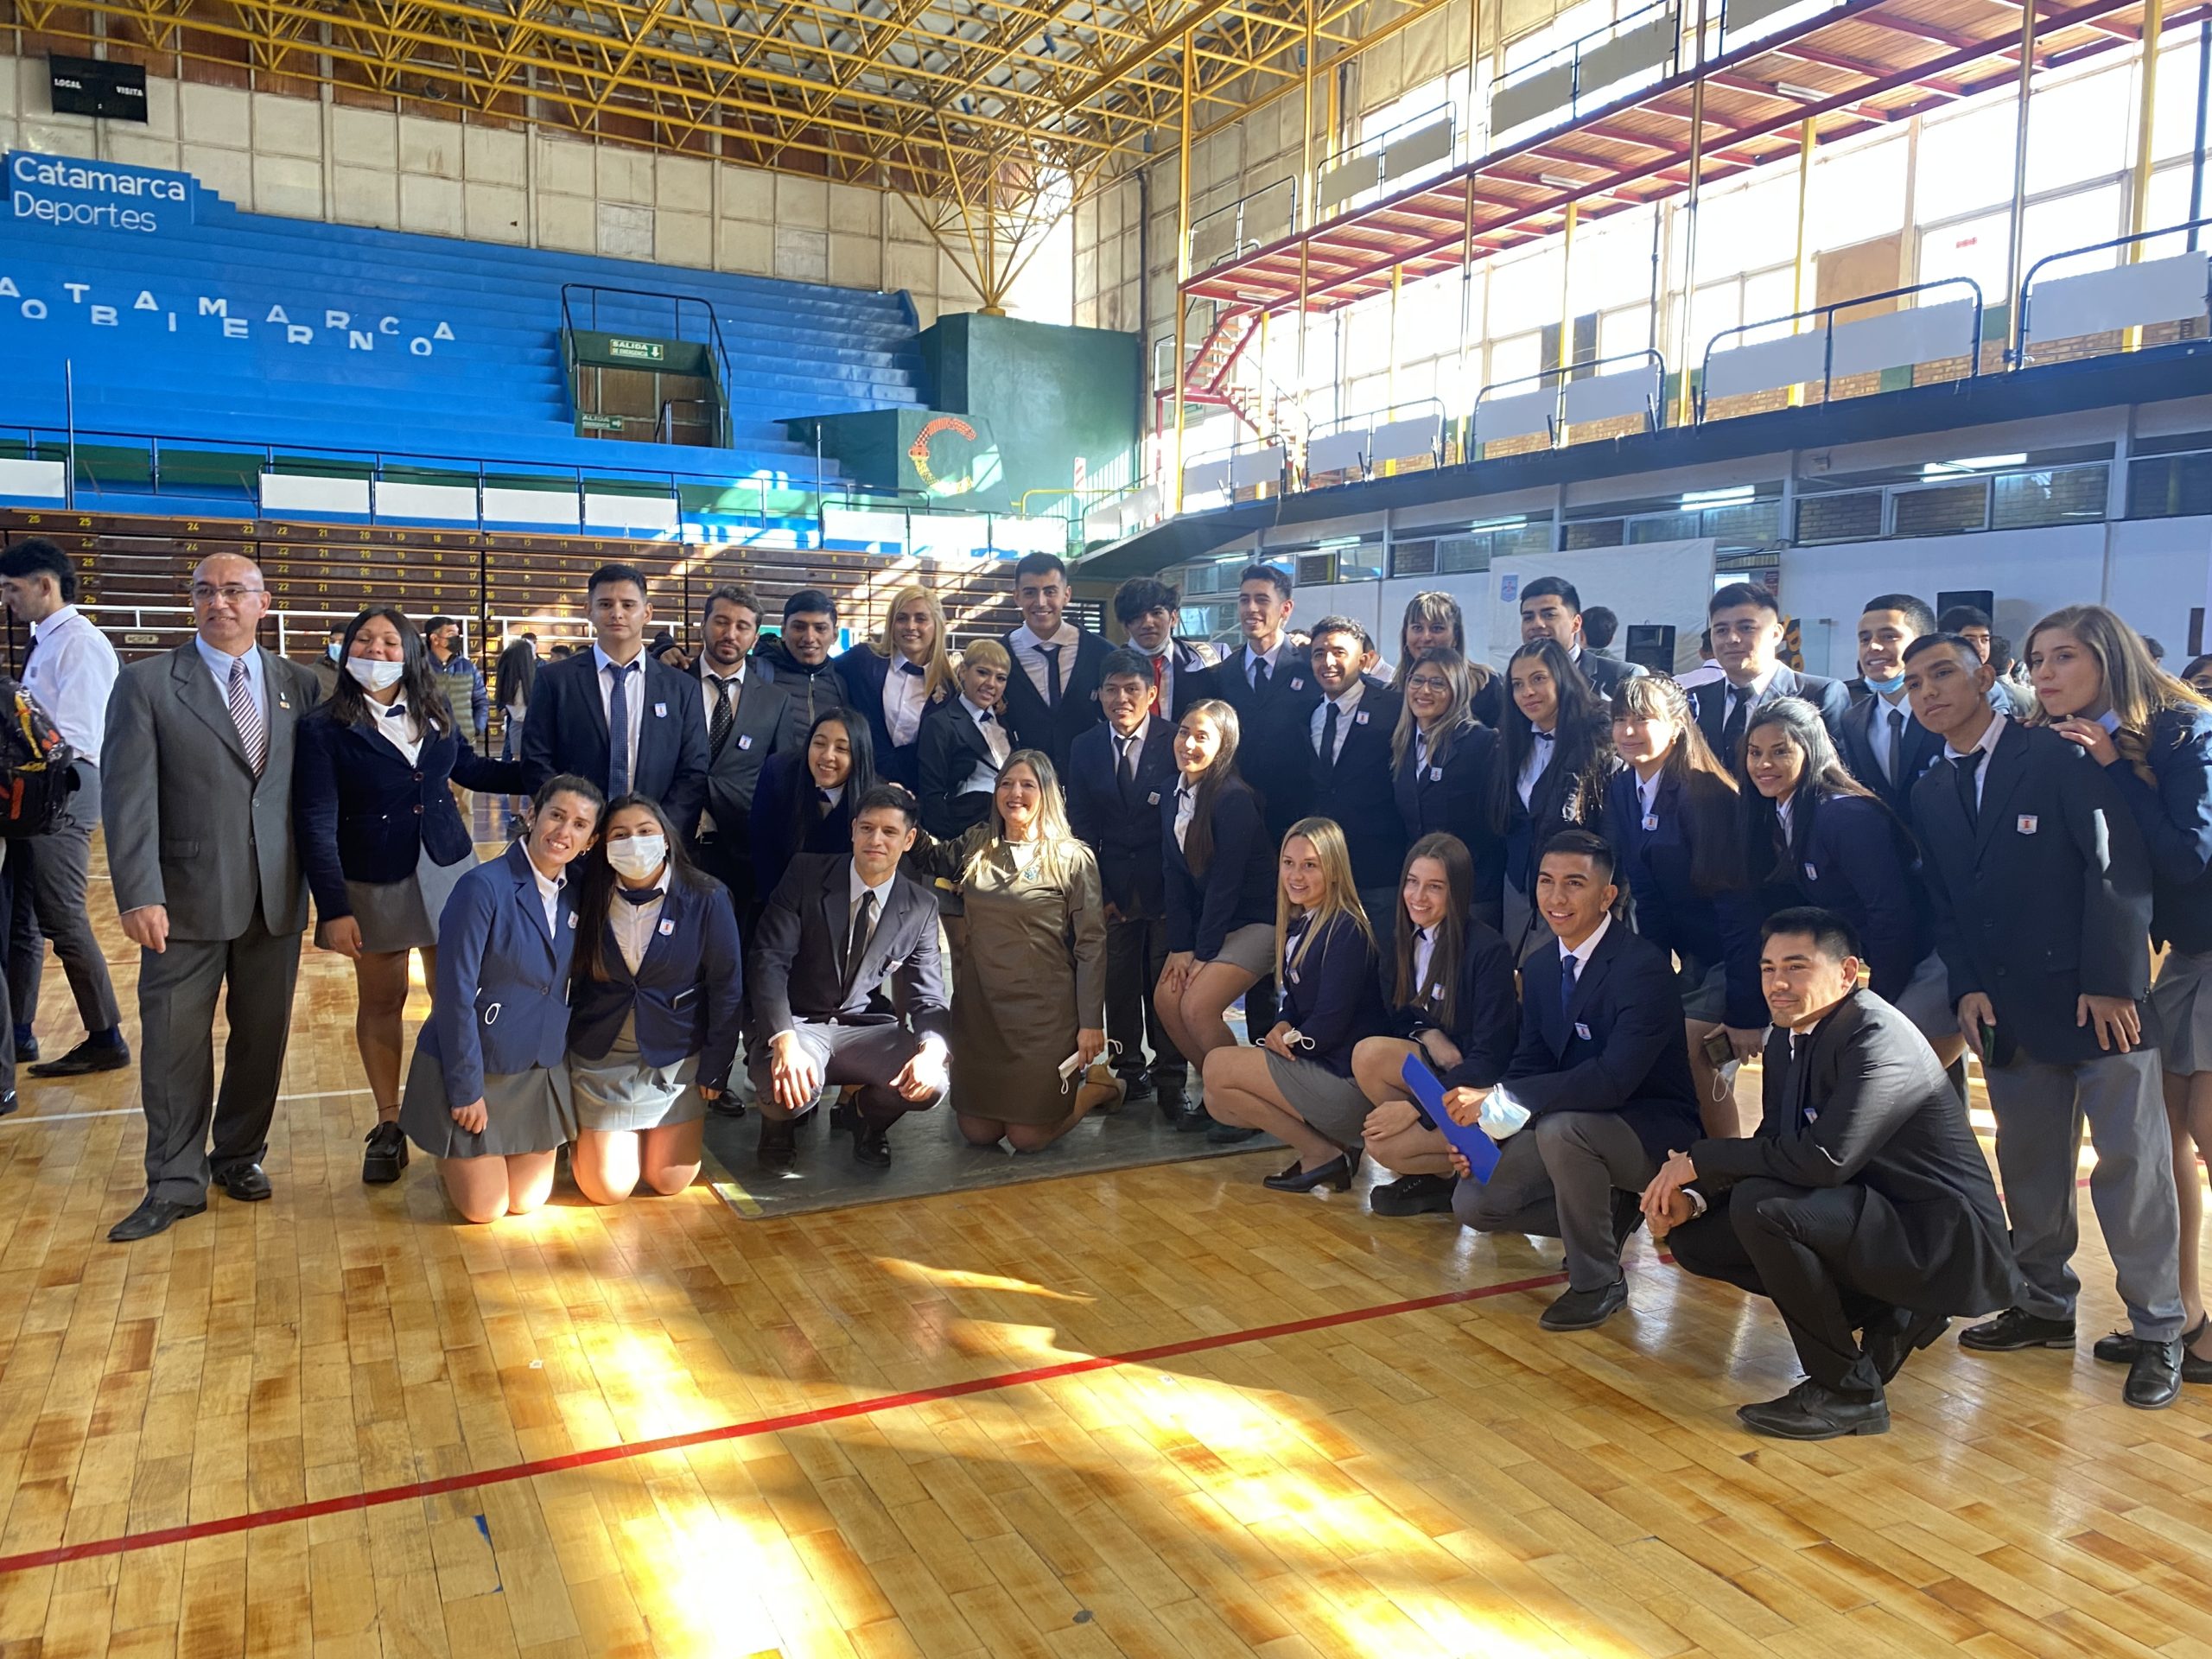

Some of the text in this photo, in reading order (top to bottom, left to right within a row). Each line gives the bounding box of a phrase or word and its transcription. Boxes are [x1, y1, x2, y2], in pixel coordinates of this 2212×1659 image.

[54, 78, 143, 97] LOCAL VISITA
[14, 156, 187, 201] Catamarca
[14, 189, 157, 232] Deportes
[612, 340, 649, 351] SALIDA
